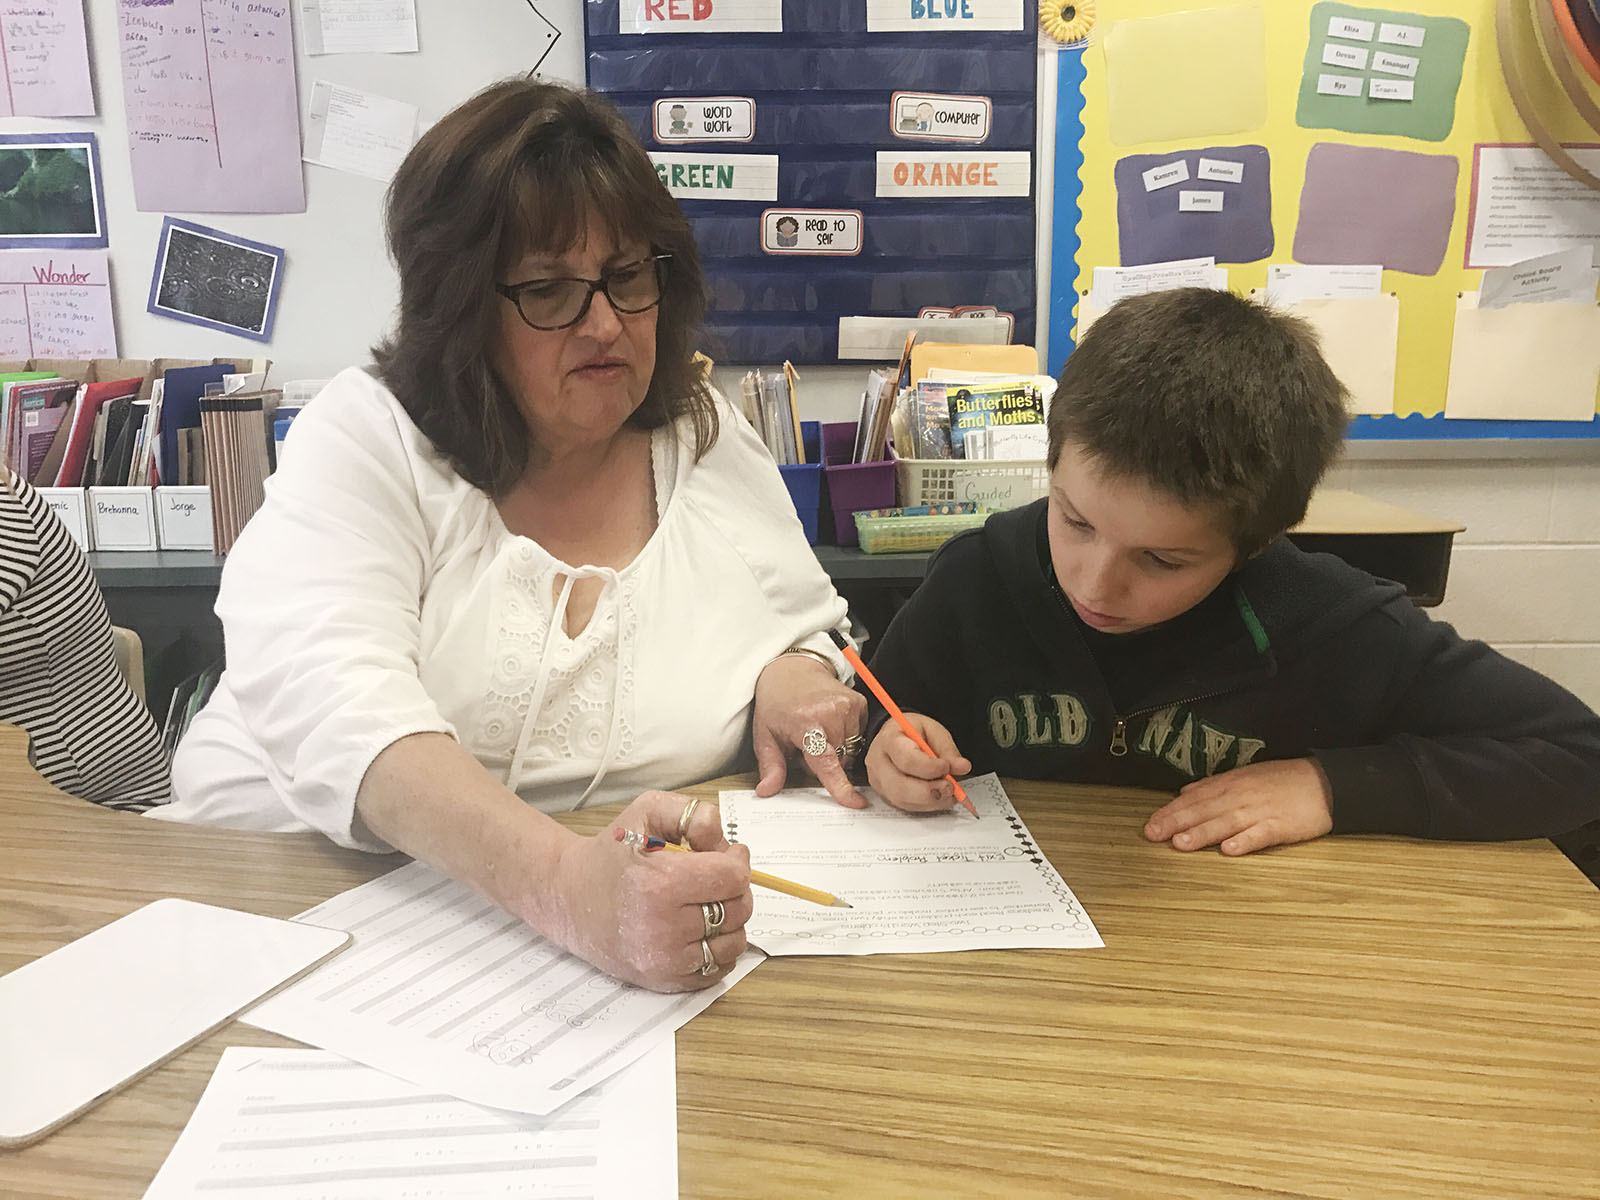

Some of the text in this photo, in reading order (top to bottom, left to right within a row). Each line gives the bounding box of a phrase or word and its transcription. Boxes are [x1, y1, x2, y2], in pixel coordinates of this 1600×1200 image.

[644, 0, 713, 21] RED
[910, 0, 974, 20] BLUE
[655, 164, 735, 189] GREEN
[893, 162, 999, 187] ORANGE
[33, 259, 91, 285] Wonder
[956, 394, 1034, 414] Butterflies
[957, 413, 985, 429] and
[990, 410, 1036, 426] Moths
[965, 482, 1012, 501] Guided
[170, 497, 196, 517] Jorge
[989, 692, 1090, 749] OLD
